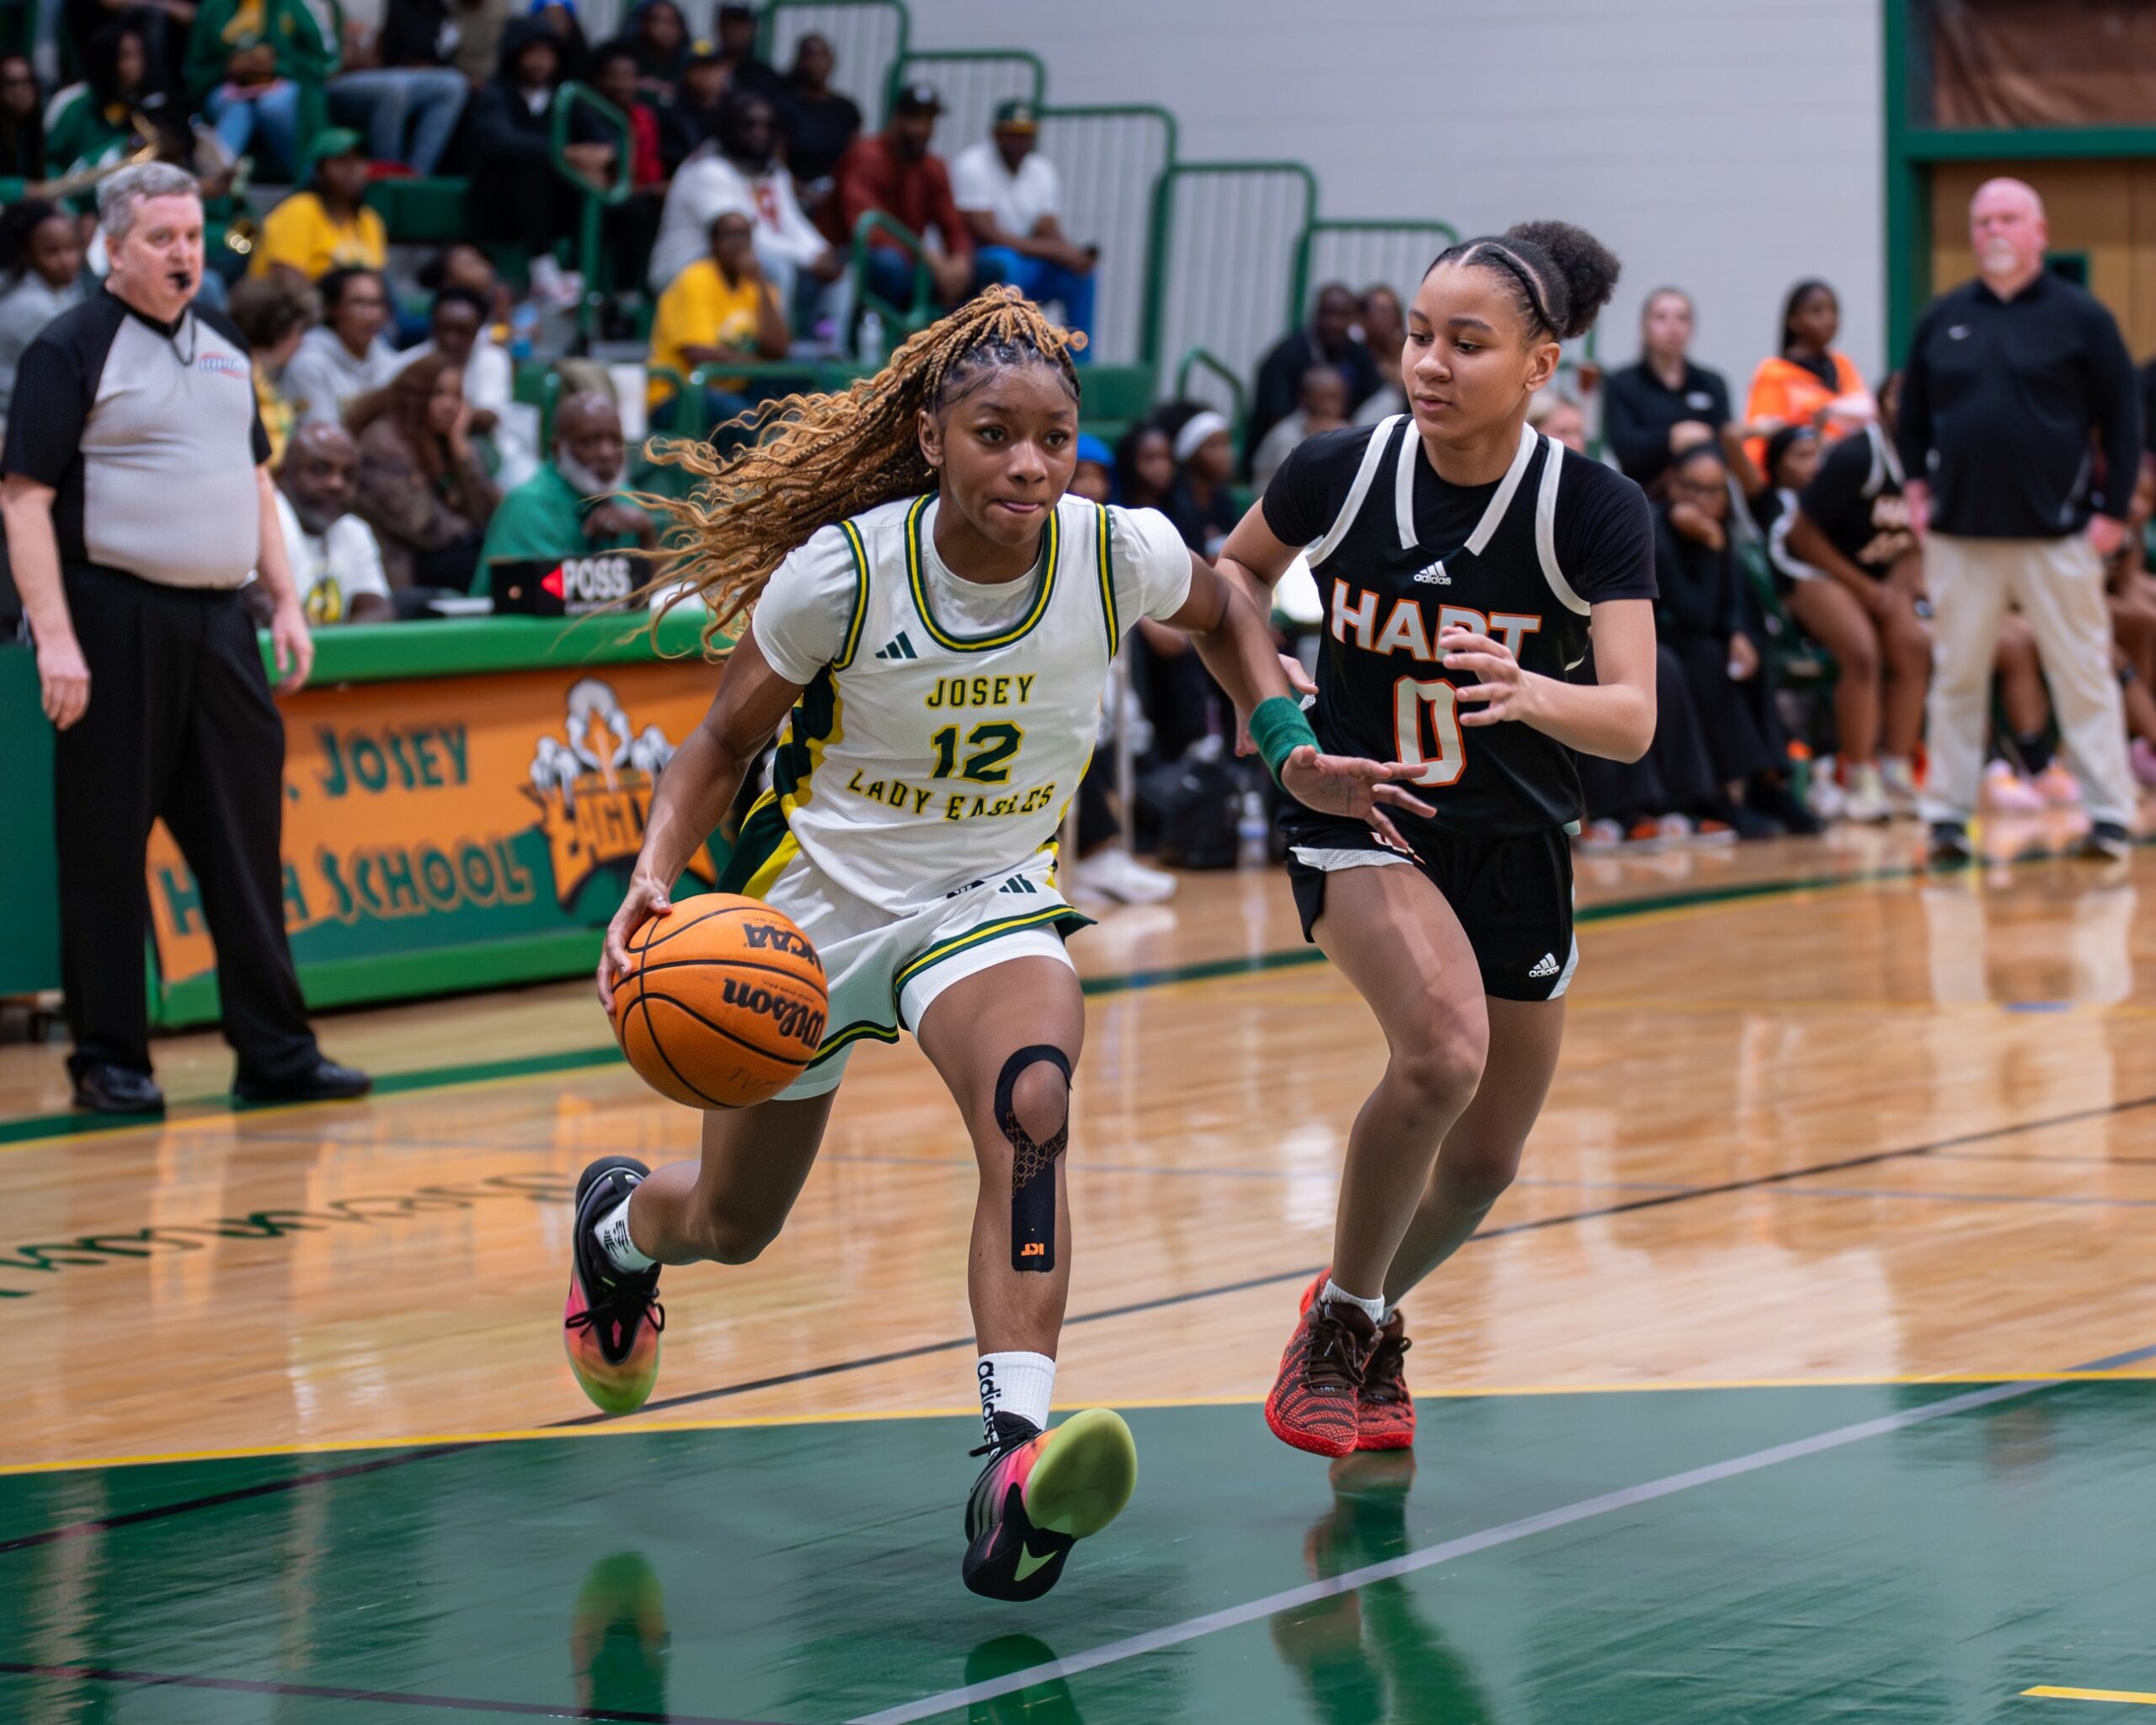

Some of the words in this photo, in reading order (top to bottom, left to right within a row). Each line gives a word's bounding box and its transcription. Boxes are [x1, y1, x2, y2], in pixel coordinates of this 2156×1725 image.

[561, 557, 632, 601] POSS
[1413, 573, 1452, 586] adidas
[925, 671, 1038, 710] JOSEY
[315, 723, 470, 798] JOSEY
[930, 719, 1025, 785] 12
[1393, 675, 1468, 788] 0
[846, 767, 936, 815] LADY
[943, 781, 1058, 822] EAGLES
[316, 838, 534, 924] SCHOOL
[1529, 964, 1561, 978] adidas
[722, 976, 826, 1051] Wilson
[977, 1360, 1001, 1450] adida
